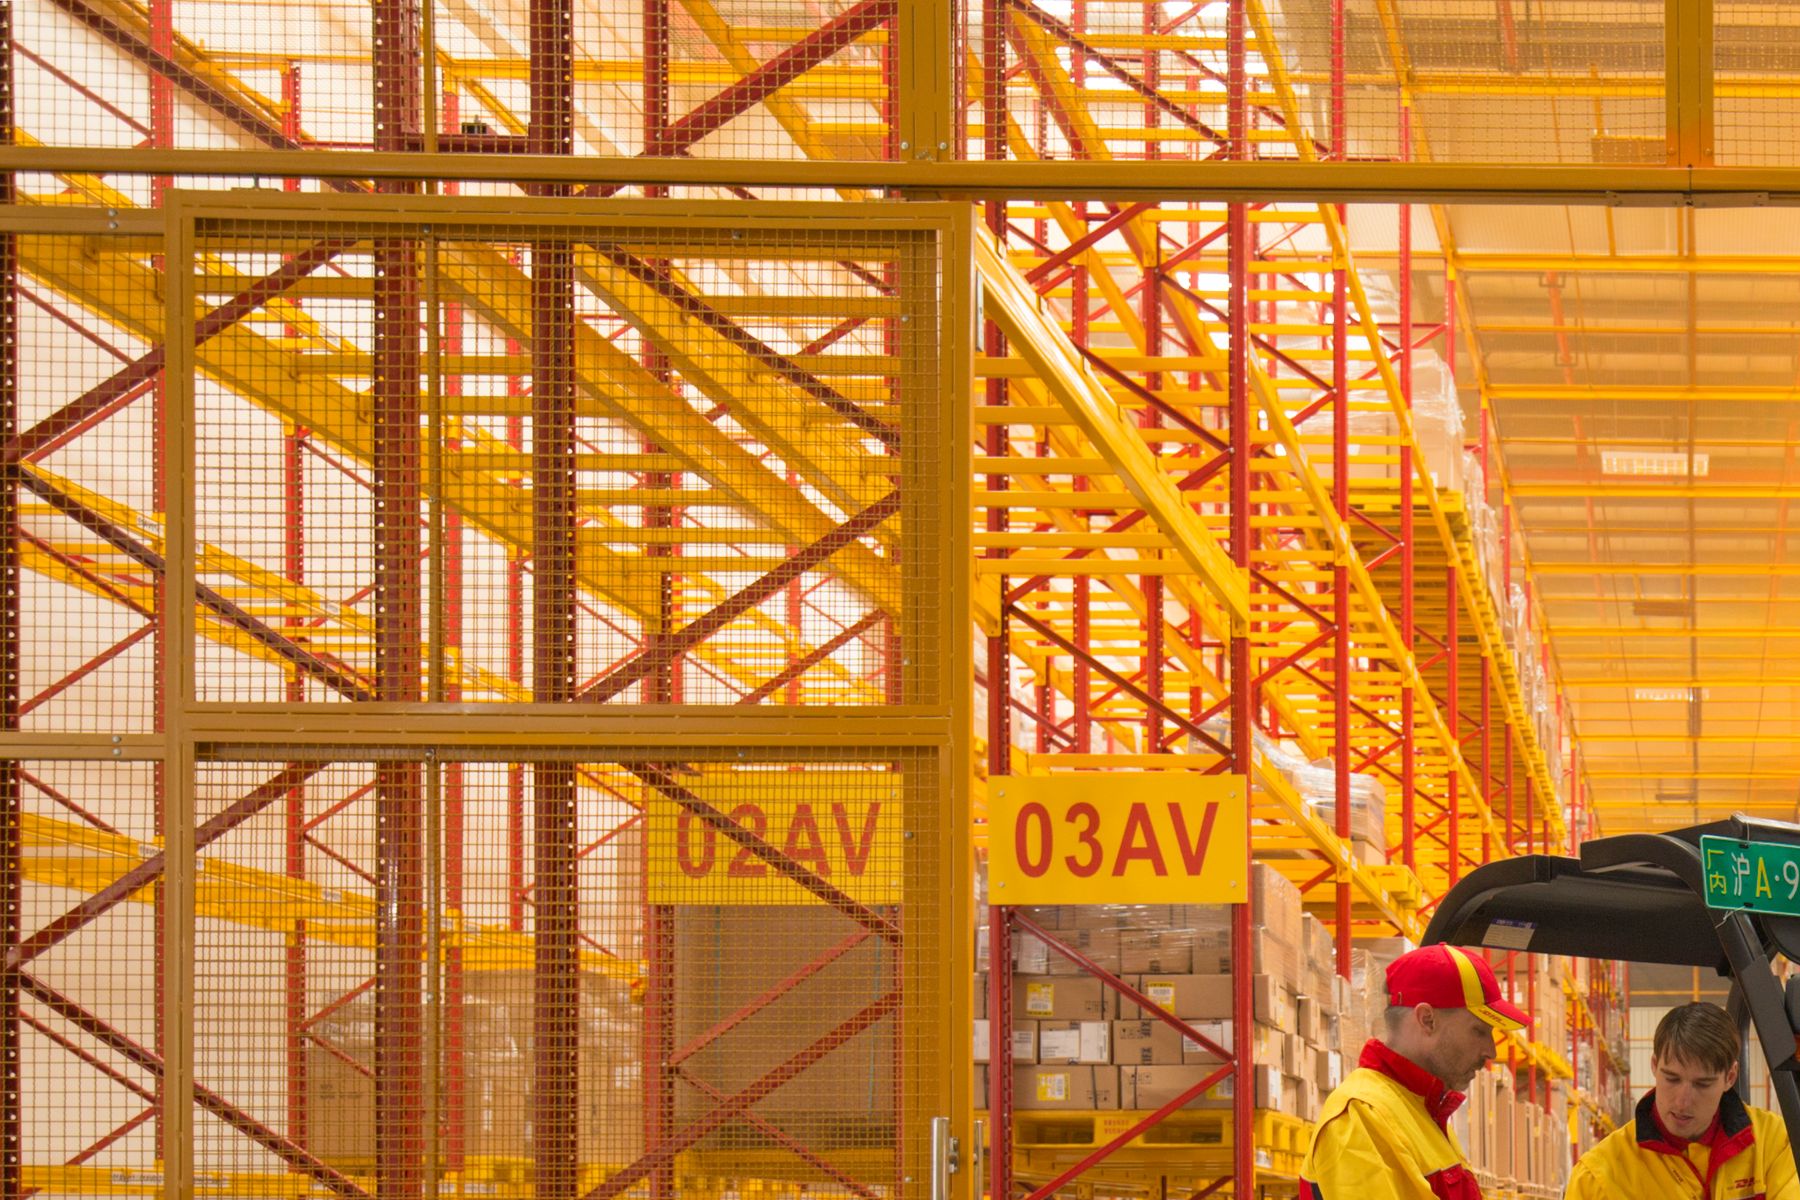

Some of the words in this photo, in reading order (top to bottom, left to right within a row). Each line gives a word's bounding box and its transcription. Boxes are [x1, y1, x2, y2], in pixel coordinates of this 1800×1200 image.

[676, 801, 881, 879] 02AV
[1014, 801, 1220, 879] 03AV
[1707, 848, 1727, 895] 厂内
